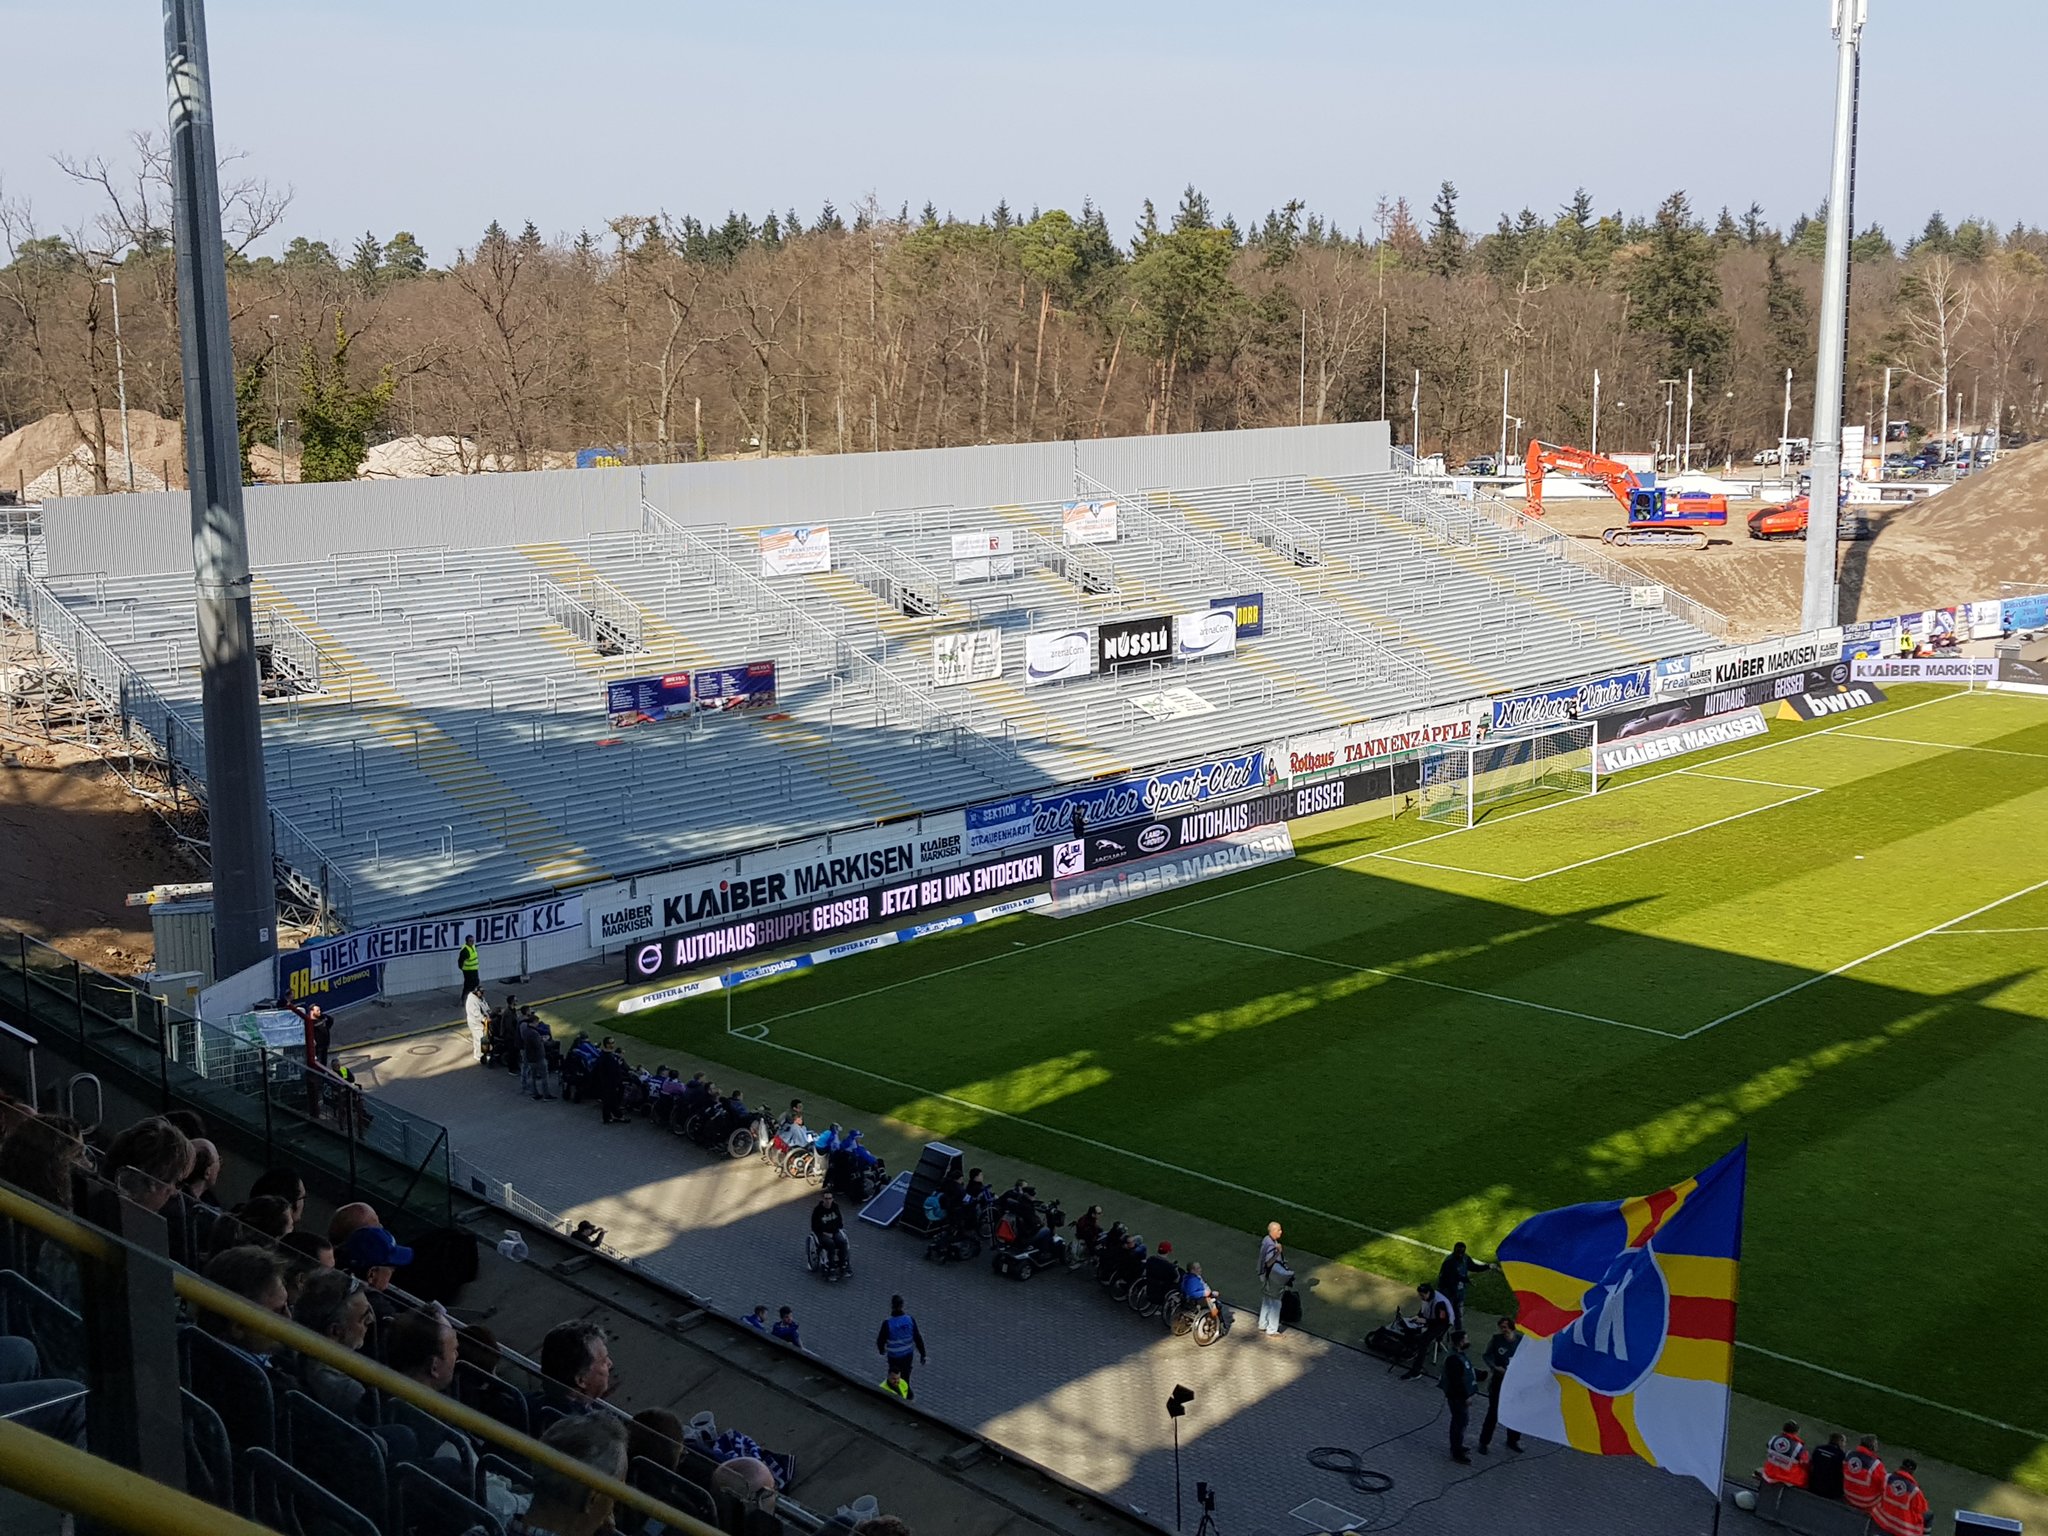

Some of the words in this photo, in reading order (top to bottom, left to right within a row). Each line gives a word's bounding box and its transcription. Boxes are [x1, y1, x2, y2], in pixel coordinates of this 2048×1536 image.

[1050, 646, 1085, 659] arenaCom
[1665, 658, 1686, 674] KSC
[1767, 644, 1818, 672] MARKISEN
[1925, 664, 1993, 677] MARKISEN
[1575, 679, 1623, 711] Phönix
[1623, 669, 1646, 698] e.V.
[1774, 673, 1805, 699] GEISSER
[1803, 684, 1874, 717] bwin
[1683, 713, 1764, 751] MARKISEN
[1289, 750, 1335, 775] Rothaus
[1343, 719, 1472, 763] TANNENZÄPFLE
[1142, 756, 1253, 814] Sport-Club
[1296, 781, 1345, 816] GEISSER
[983, 802, 1017, 821] SEKTION
[970, 823, 1032, 848] STRAUBENHARDT
[920, 845, 961, 863] MARKISEN
[1092, 850, 1128, 865] JAGUAR
[1183, 833, 1294, 882] MARKISEN
[794, 842, 914, 897] MARKISEN
[812, 896, 869, 932] GEISSER
[880, 884, 919, 916] JETZT
[920, 878, 942, 906] BEI
[944, 871, 972, 900] UNS
[973, 854, 1043, 893] ENTDECKEN
[321, 938, 361, 975] HIER
[366, 921, 465, 960] REGIERT
[475, 913, 520, 943] DER
[532, 902, 566, 933] KSC
[602, 916, 654, 939] MARKISEN
[829, 942, 860, 956] PFEIFFER
[864, 937, 880, 948] MAY
[642, 988, 677, 1003] PFEIFFER
[683, 982, 700, 994] MAY
